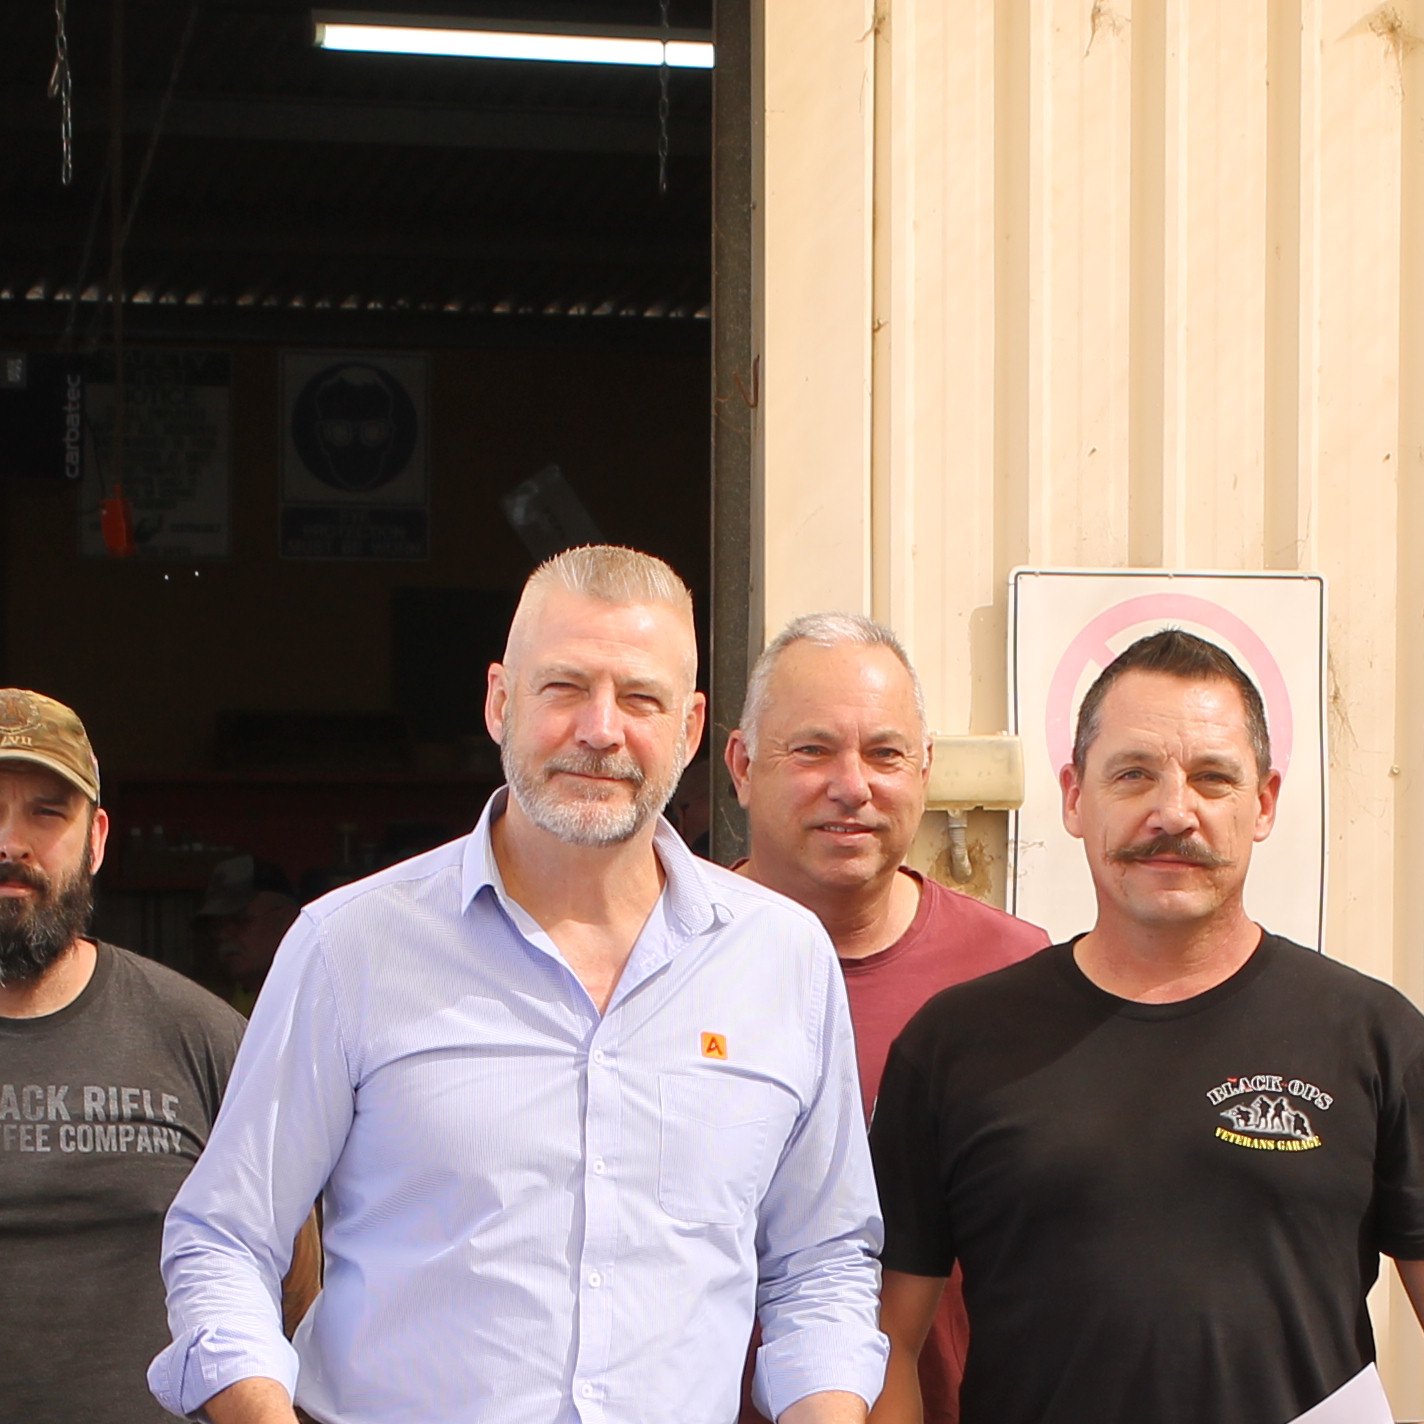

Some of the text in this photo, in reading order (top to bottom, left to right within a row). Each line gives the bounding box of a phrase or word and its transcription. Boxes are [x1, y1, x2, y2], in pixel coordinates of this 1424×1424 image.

[62, 373, 81, 480] carbatec
[302, 524, 406, 539] PROTECTION
[1206, 1075, 1334, 1111] BLACK OPS
[59, 1124, 182, 1154] COMPANY
[1215, 1126, 1322, 1151] VETERANS GARAGE
